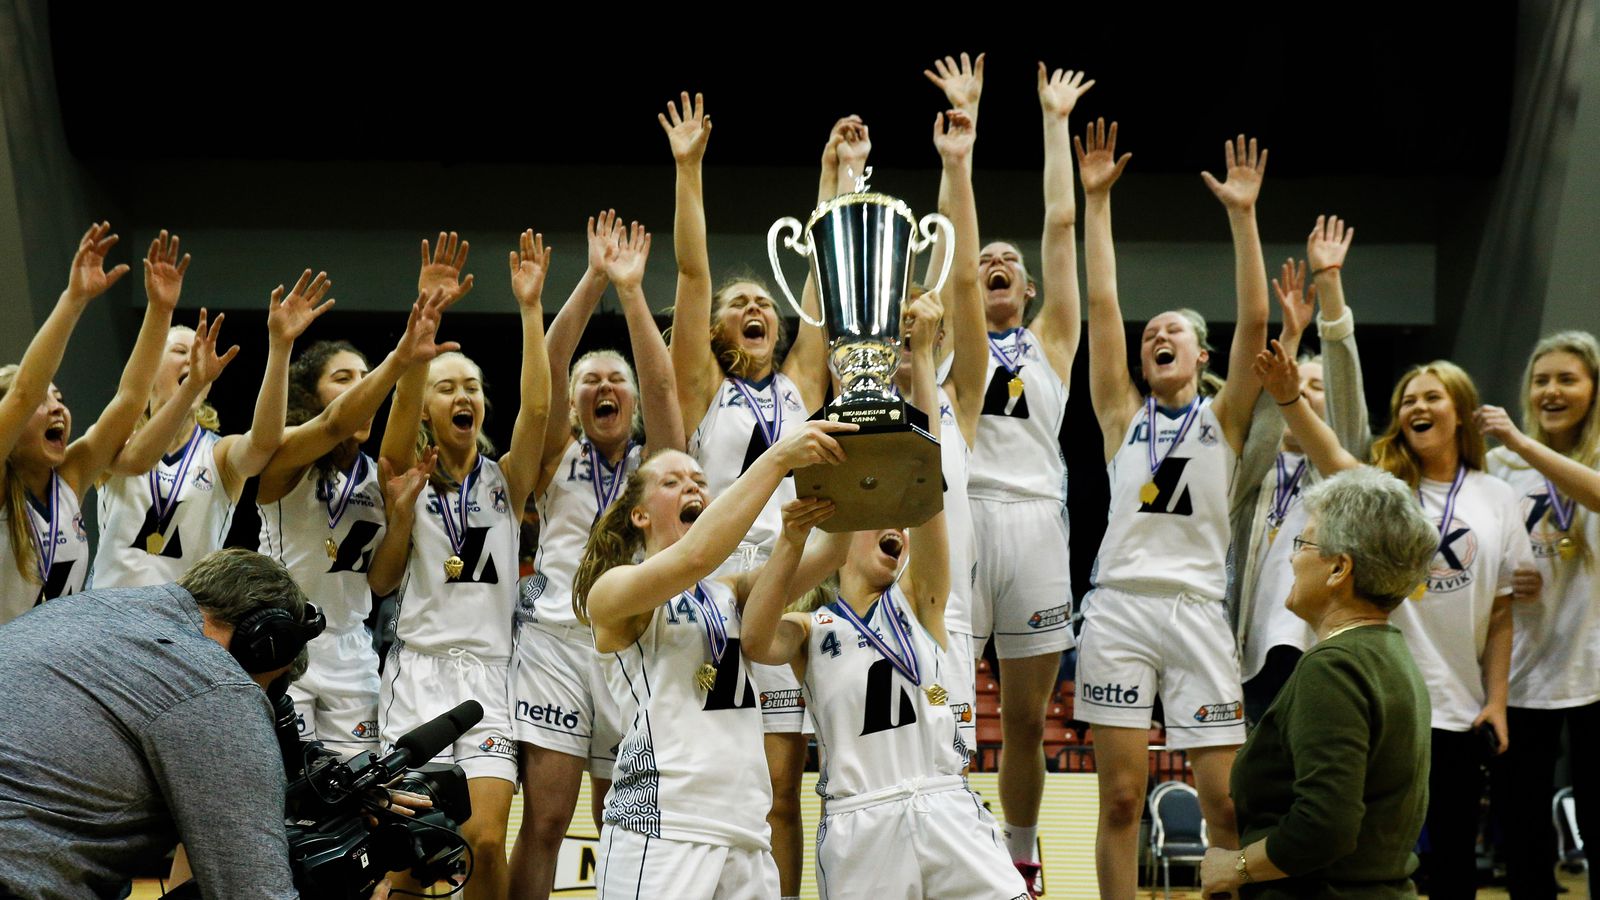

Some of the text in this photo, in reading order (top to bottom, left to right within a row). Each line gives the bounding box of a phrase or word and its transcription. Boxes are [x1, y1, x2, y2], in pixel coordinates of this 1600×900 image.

[566, 457, 593, 482] 13
[1425, 572, 1470, 591] LAVIK
[666, 596, 698, 625] 14
[821, 630, 841, 658] 4
